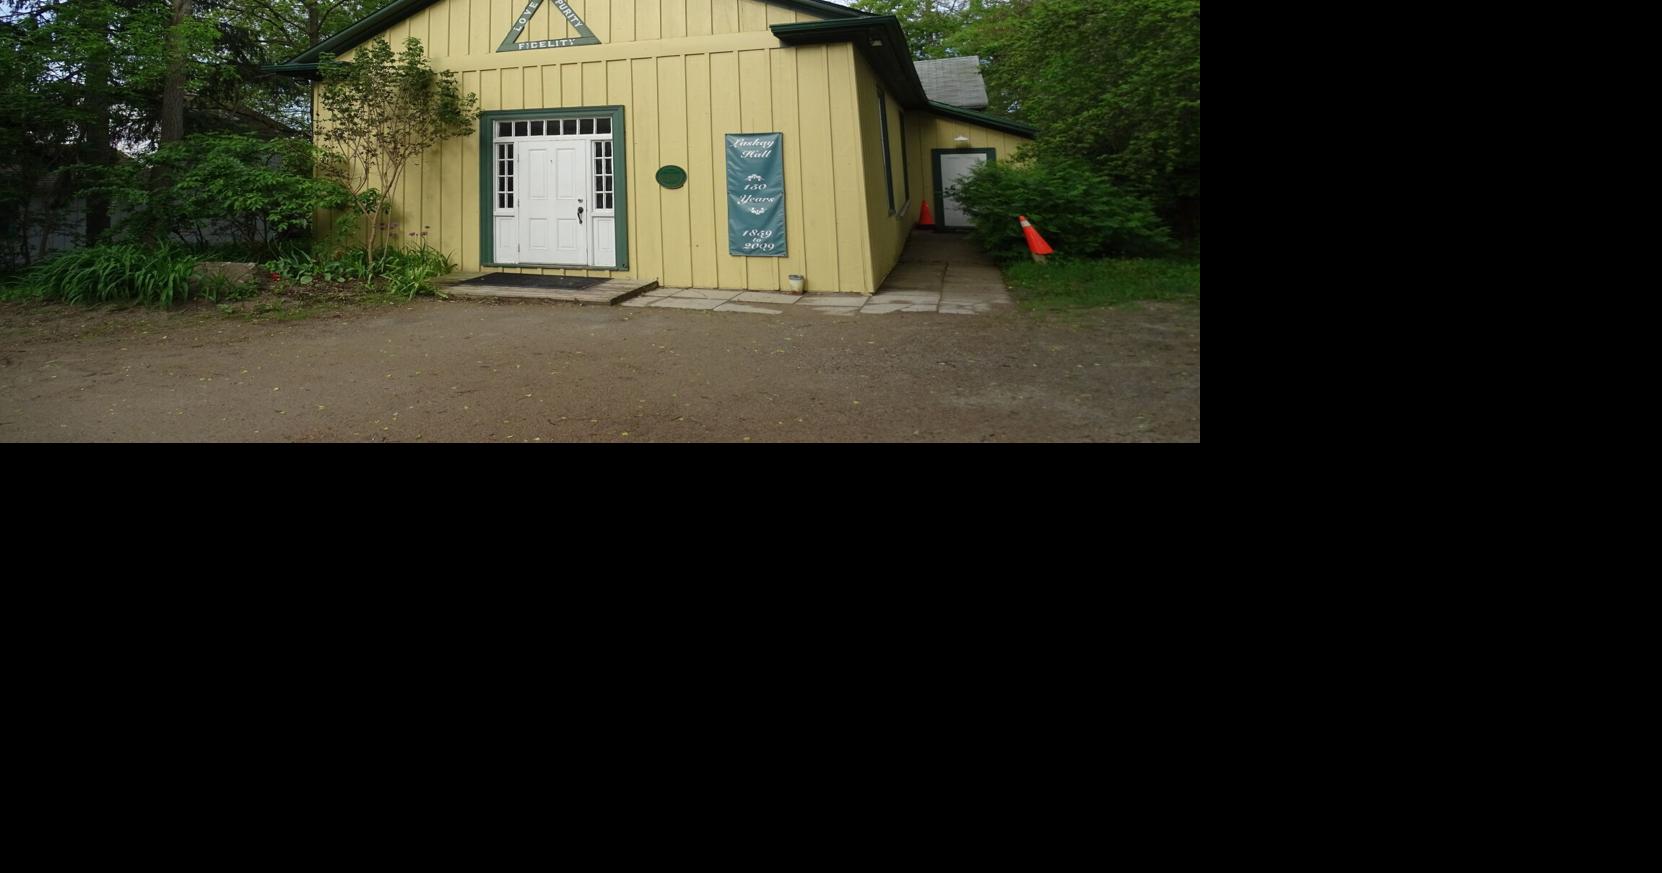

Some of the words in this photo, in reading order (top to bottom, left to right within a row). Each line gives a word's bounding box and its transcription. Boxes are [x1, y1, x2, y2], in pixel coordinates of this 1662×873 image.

[513, 1, 539, 32] LOVE
[555, 0, 583, 28] PURITY
[518, 38, 576, 50] FIDELITY
[740, 150, 772, 158] Hall
[737, 194, 775, 204] Years
[742, 229, 773, 239] 1859
[743, 242, 775, 251] 2009
